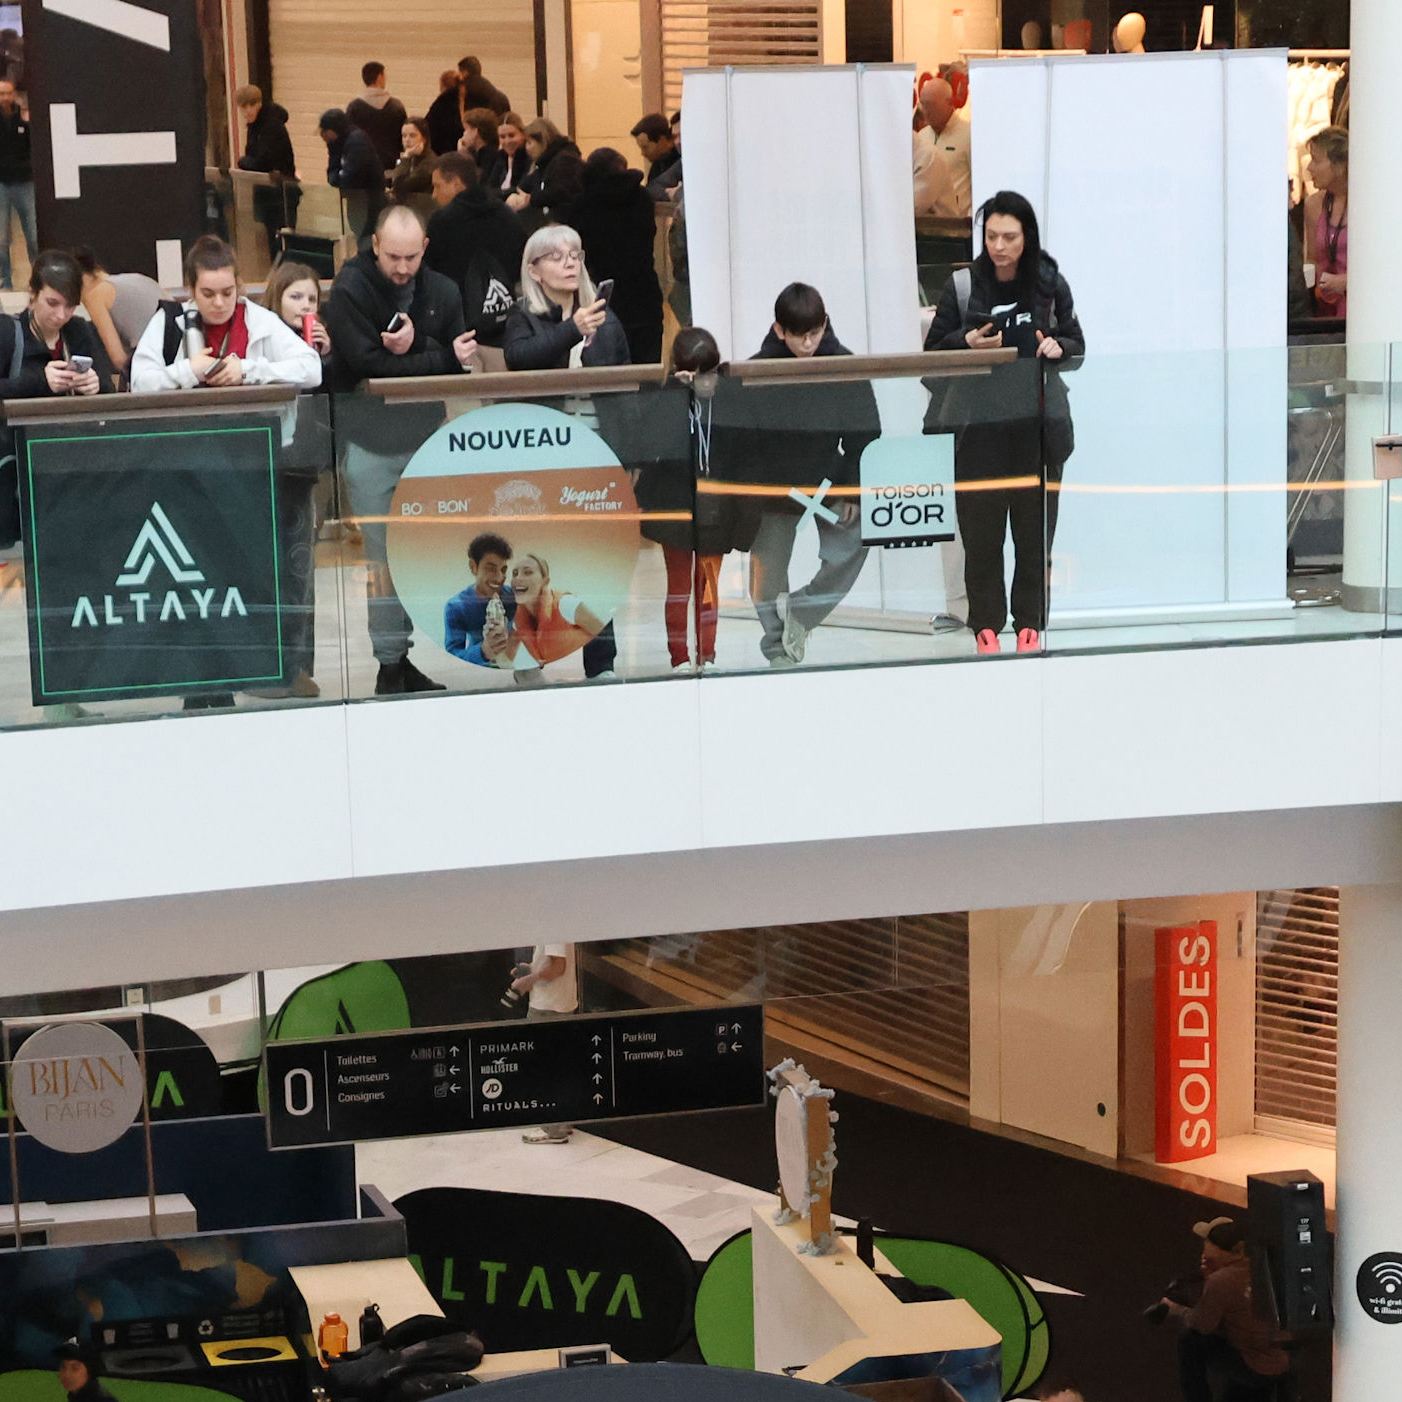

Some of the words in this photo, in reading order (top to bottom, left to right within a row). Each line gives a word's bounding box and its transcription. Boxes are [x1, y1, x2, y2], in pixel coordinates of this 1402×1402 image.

[449, 426, 572, 452] NOUVEAU
[559, 486, 608, 507] Yogurt
[584, 501, 622, 511] FACTORY
[71, 586, 248, 627] ALTAYA
[622, 1031, 657, 1043] Parking
[1178, 935, 1211, 1149] SOLDES
[480, 1041, 534, 1054] PRIMARK
[667, 1048, 683, 1058] bus
[337, 1054, 377, 1066] Toilettes
[480, 1063, 518, 1075] HOLLISTER
[29, 1055, 125, 1099] BIJAN
[338, 1072, 390, 1084] Ascenseurs
[338, 1091, 386, 1103] Consignes
[44, 1100, 115, 1122] PARIS
